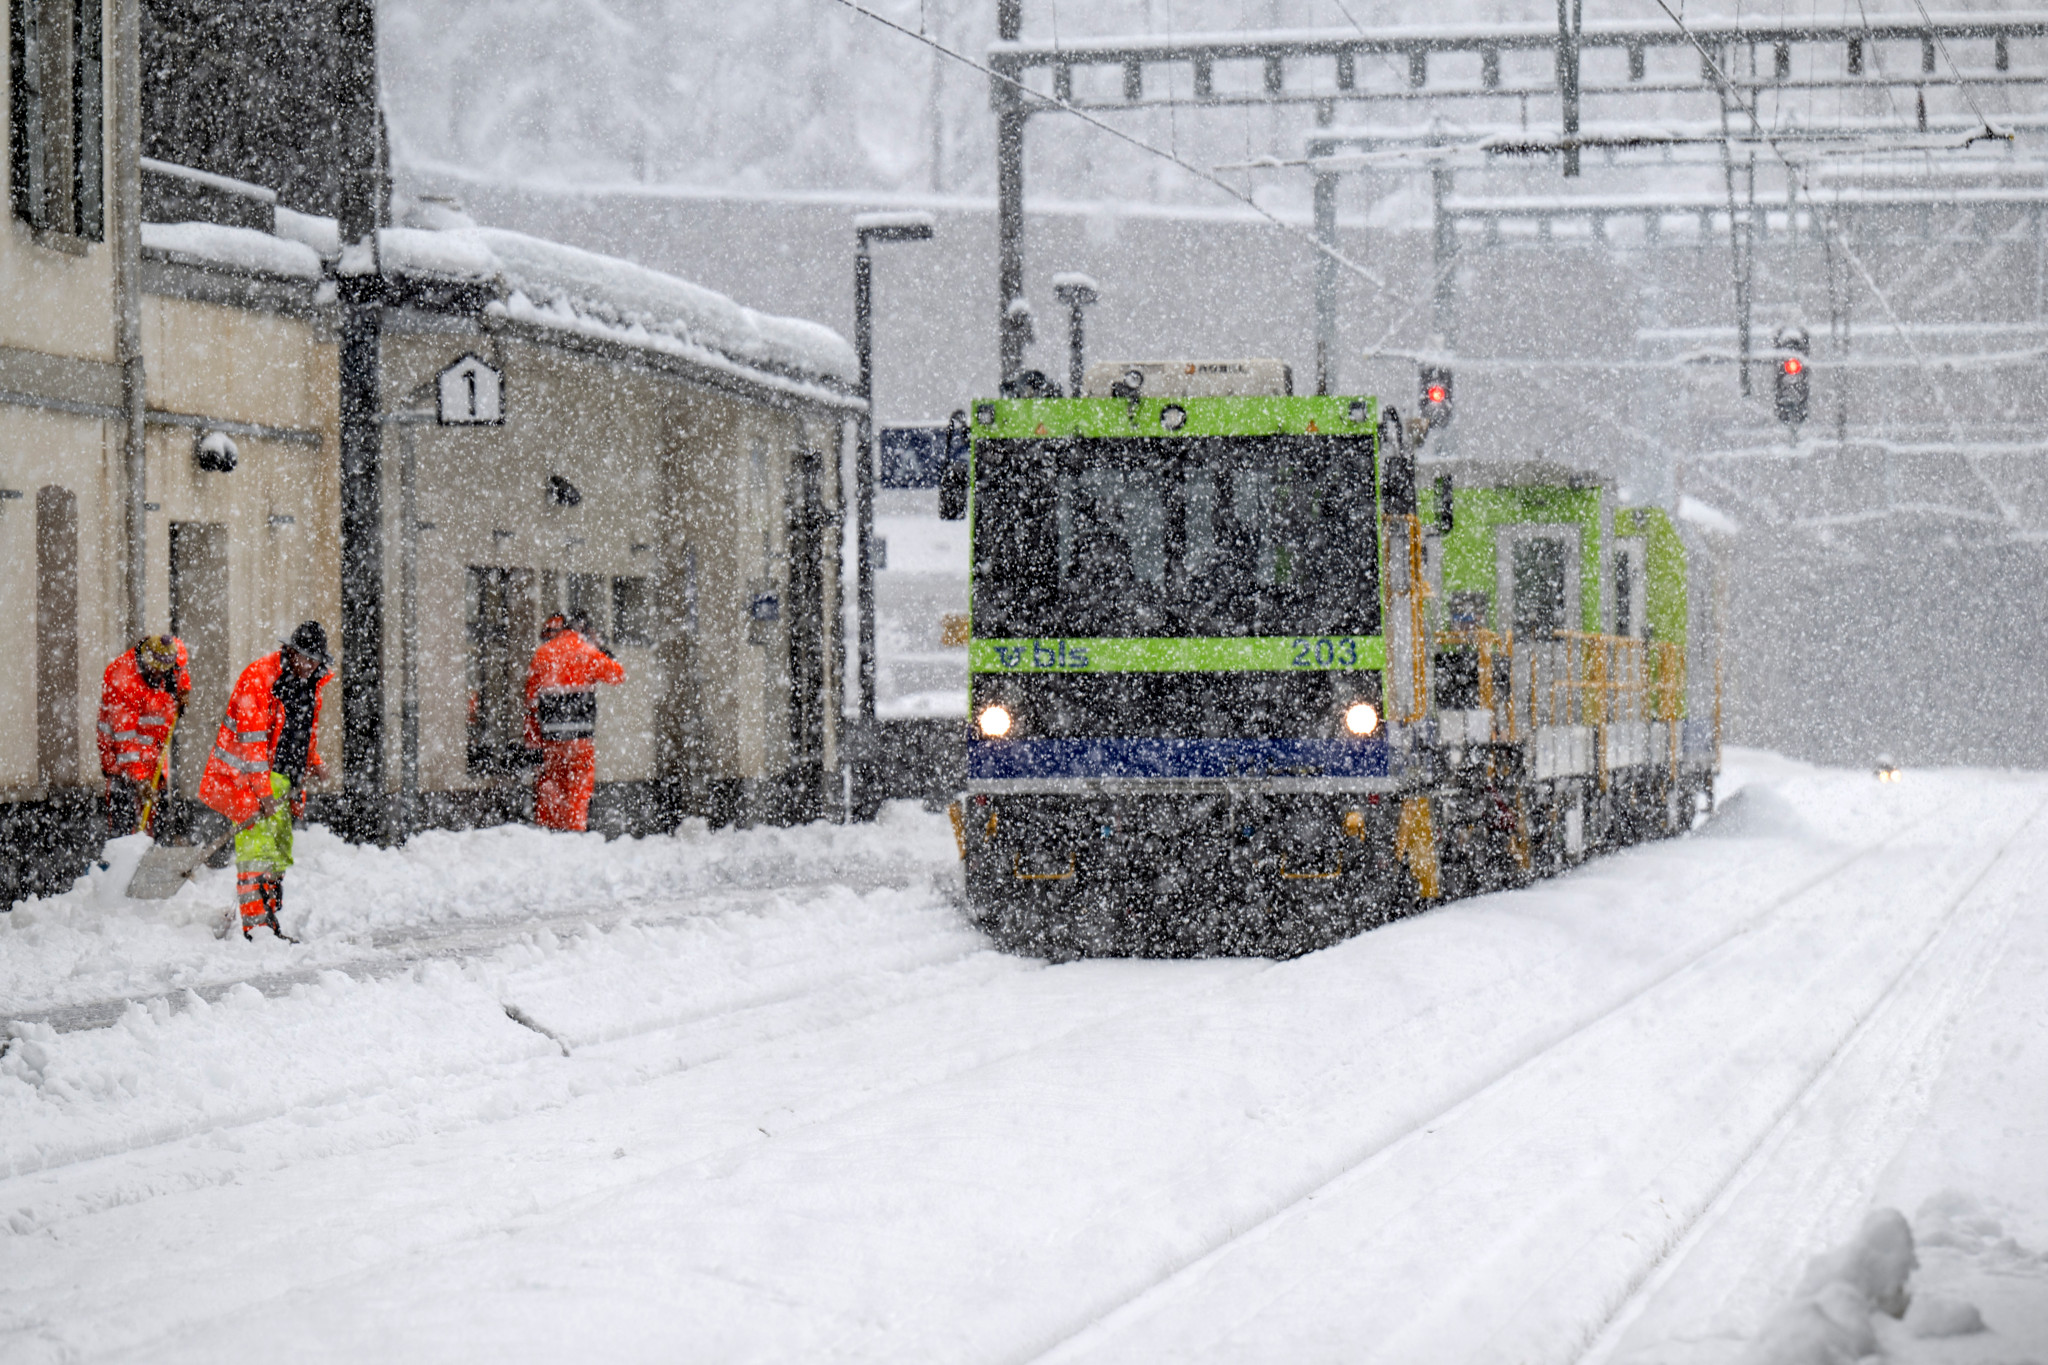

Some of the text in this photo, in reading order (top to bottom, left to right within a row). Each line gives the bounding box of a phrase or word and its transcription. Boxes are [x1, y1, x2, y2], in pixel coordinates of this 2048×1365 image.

[462, 369, 476, 416] 1
[1033, 640, 1089, 667] bls
[1292, 638, 1357, 666] 203
